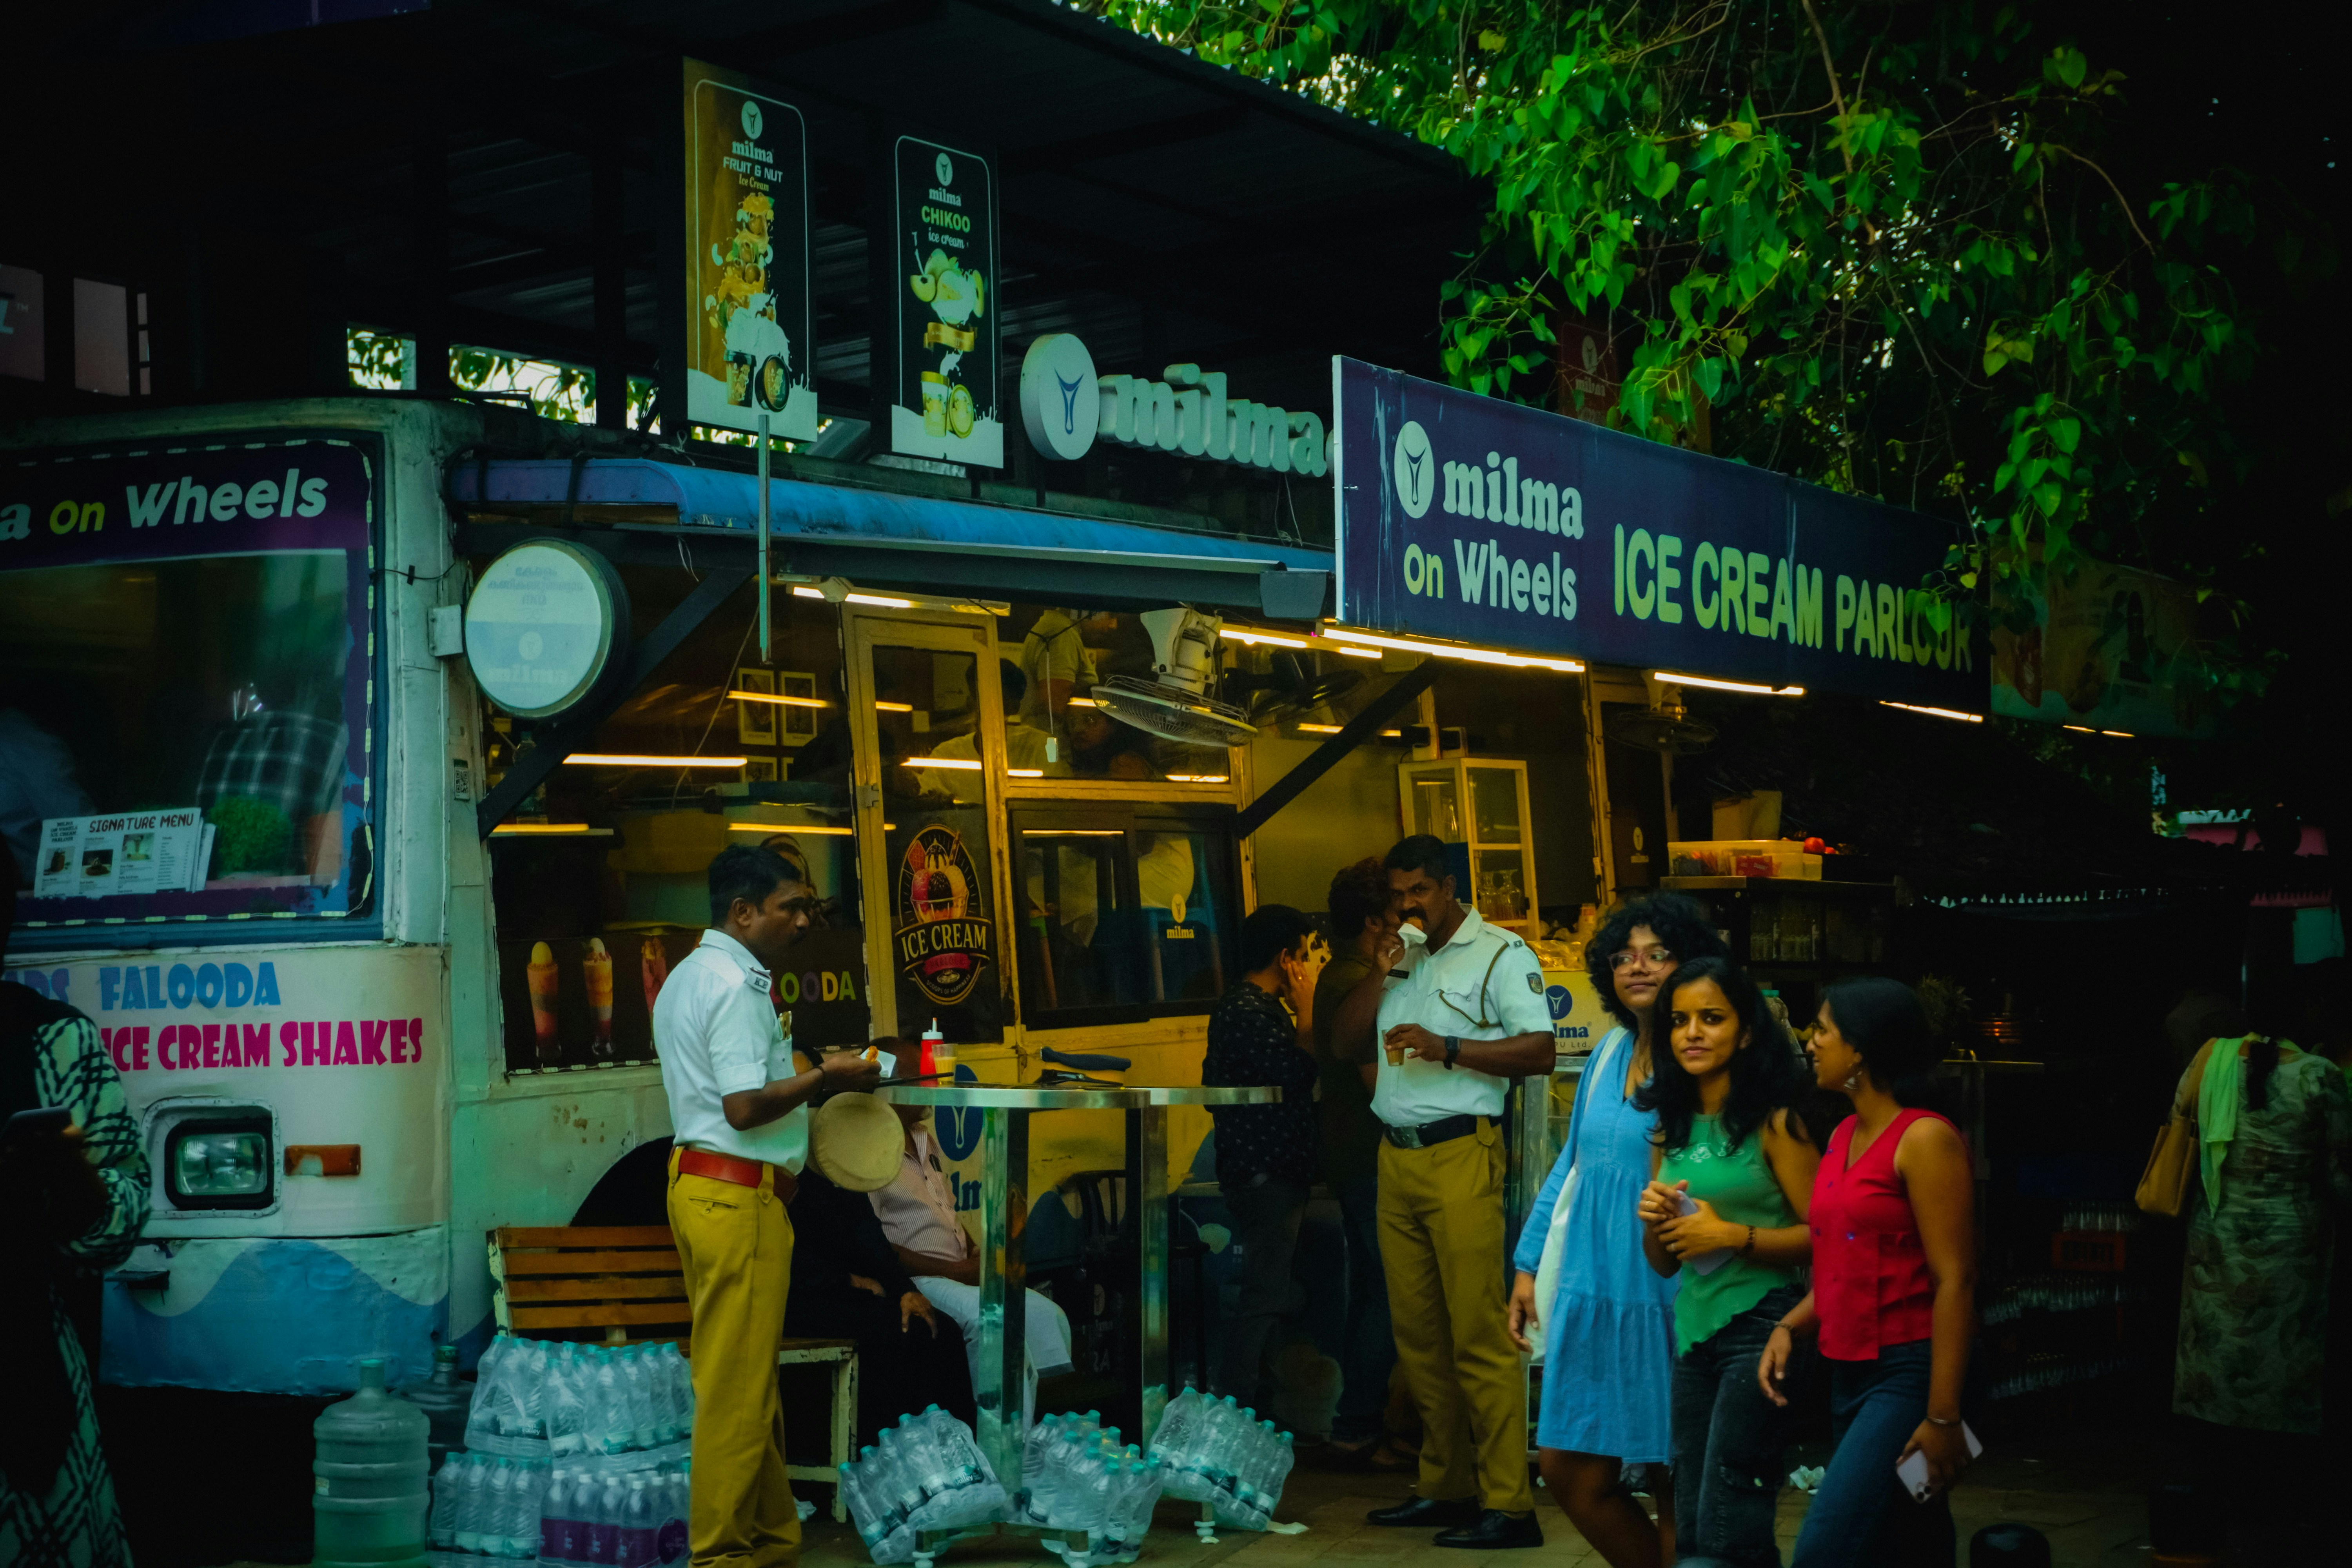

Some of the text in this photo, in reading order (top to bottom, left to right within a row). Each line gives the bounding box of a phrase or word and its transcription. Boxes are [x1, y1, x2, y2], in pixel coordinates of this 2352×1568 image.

[732, 140, 773, 164] milma
[722, 156, 783, 183] FRUIT & NUT
[739, 173, 769, 192] Ice Cream
[928, 187, 962, 207] milma
[921, 205, 971, 233] CHIKOO
[928, 227, 965, 249] ice cream
[1098, 363, 1328, 477] milma
[126, 468, 328, 529] Wheels
[1443, 451, 1584, 539] milma
[1454, 539, 1577, 621] Wheels
[1614, 523, 1682, 624] ICE
[1692, 541, 1823, 650] CREAM
[89, 813, 194, 833] SIGNATURE MENU
[901, 923, 986, 962] ICE CREAM
[1167, 926, 1195, 939] milma
[100, 962, 281, 1010] FALOODA
[157, 1023, 271, 1070] CREAM
[280, 1018, 422, 1067] SHAKES
